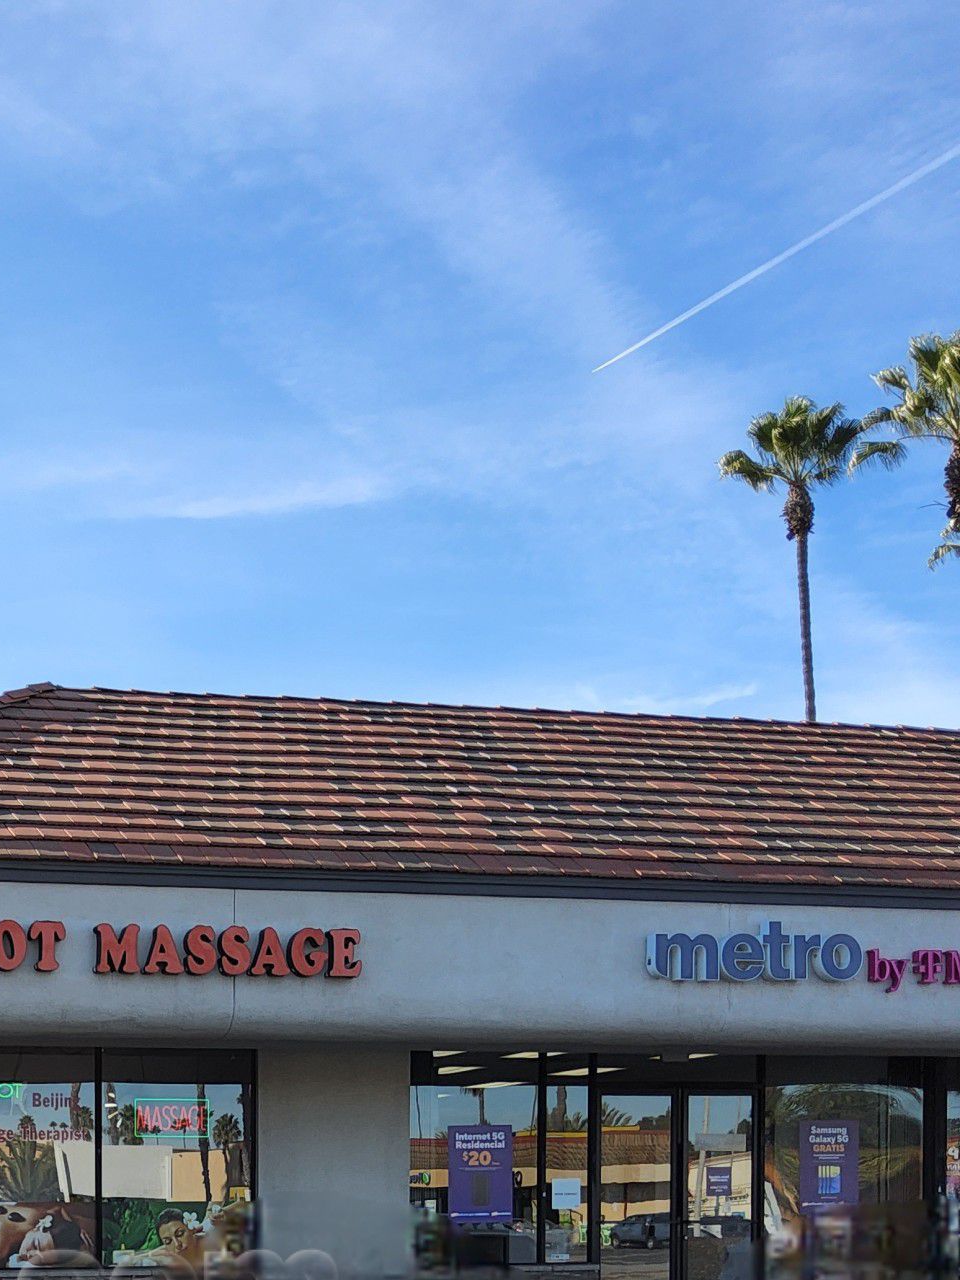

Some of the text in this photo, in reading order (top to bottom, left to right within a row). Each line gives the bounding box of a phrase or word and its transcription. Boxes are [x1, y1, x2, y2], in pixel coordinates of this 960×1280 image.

[93, 922, 362, 978] MASSAGE
[646, 921, 863, 982] metro
[866, 948, 909, 993] by
[32, 1092, 81, 1111] Beijin
[137, 1105, 207, 1132] MASSAGE
[455, 1131, 505, 1141] Internet 5G
[810, 1126, 847, 1135] Samsung
[455, 1140, 505, 1149] Residencial
[809, 1135, 849, 1144] Galaxy 5G
[812, 1144, 845, 1152] GRATIS
[462, 1150, 492, 1166] $20
